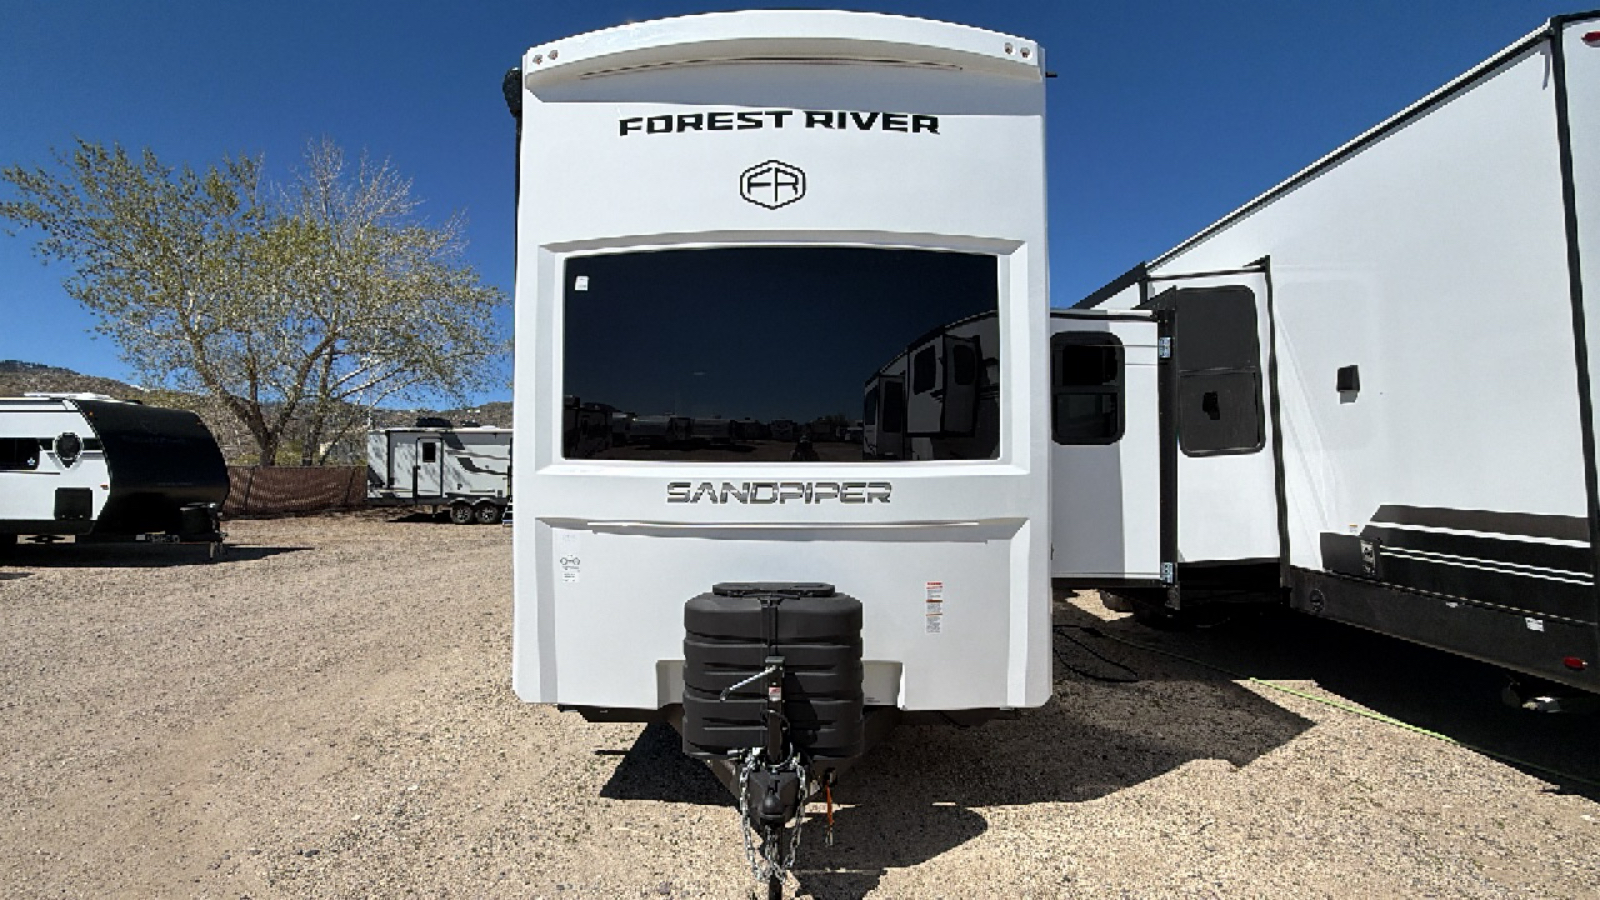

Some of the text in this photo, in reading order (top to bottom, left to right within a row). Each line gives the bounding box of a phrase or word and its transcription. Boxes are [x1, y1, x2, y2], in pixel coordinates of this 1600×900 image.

[619, 110, 940, 136] FOREST RIVER
[746, 166, 800, 203] FR
[667, 482, 892, 504] SANDPIPER
